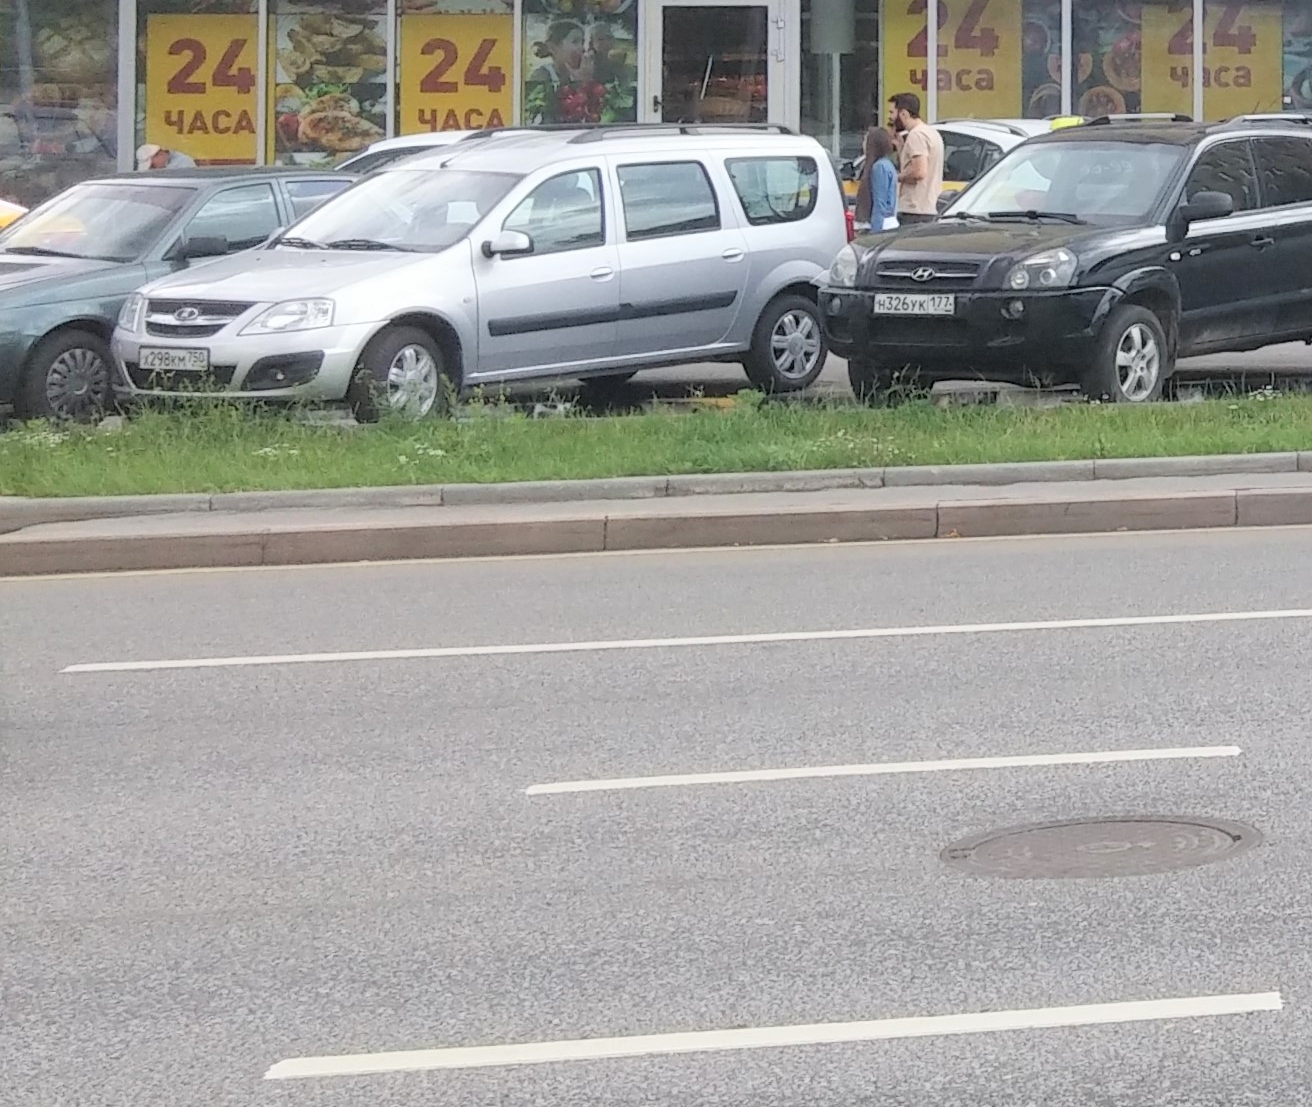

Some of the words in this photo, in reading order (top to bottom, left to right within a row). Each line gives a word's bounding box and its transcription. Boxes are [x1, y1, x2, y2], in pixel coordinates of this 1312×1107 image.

[167, 38, 256, 94] 24
[419, 38, 506, 94] 24
[164, 109, 256, 135] ЧАСА
[418, 108, 505, 131] ЧАСА
